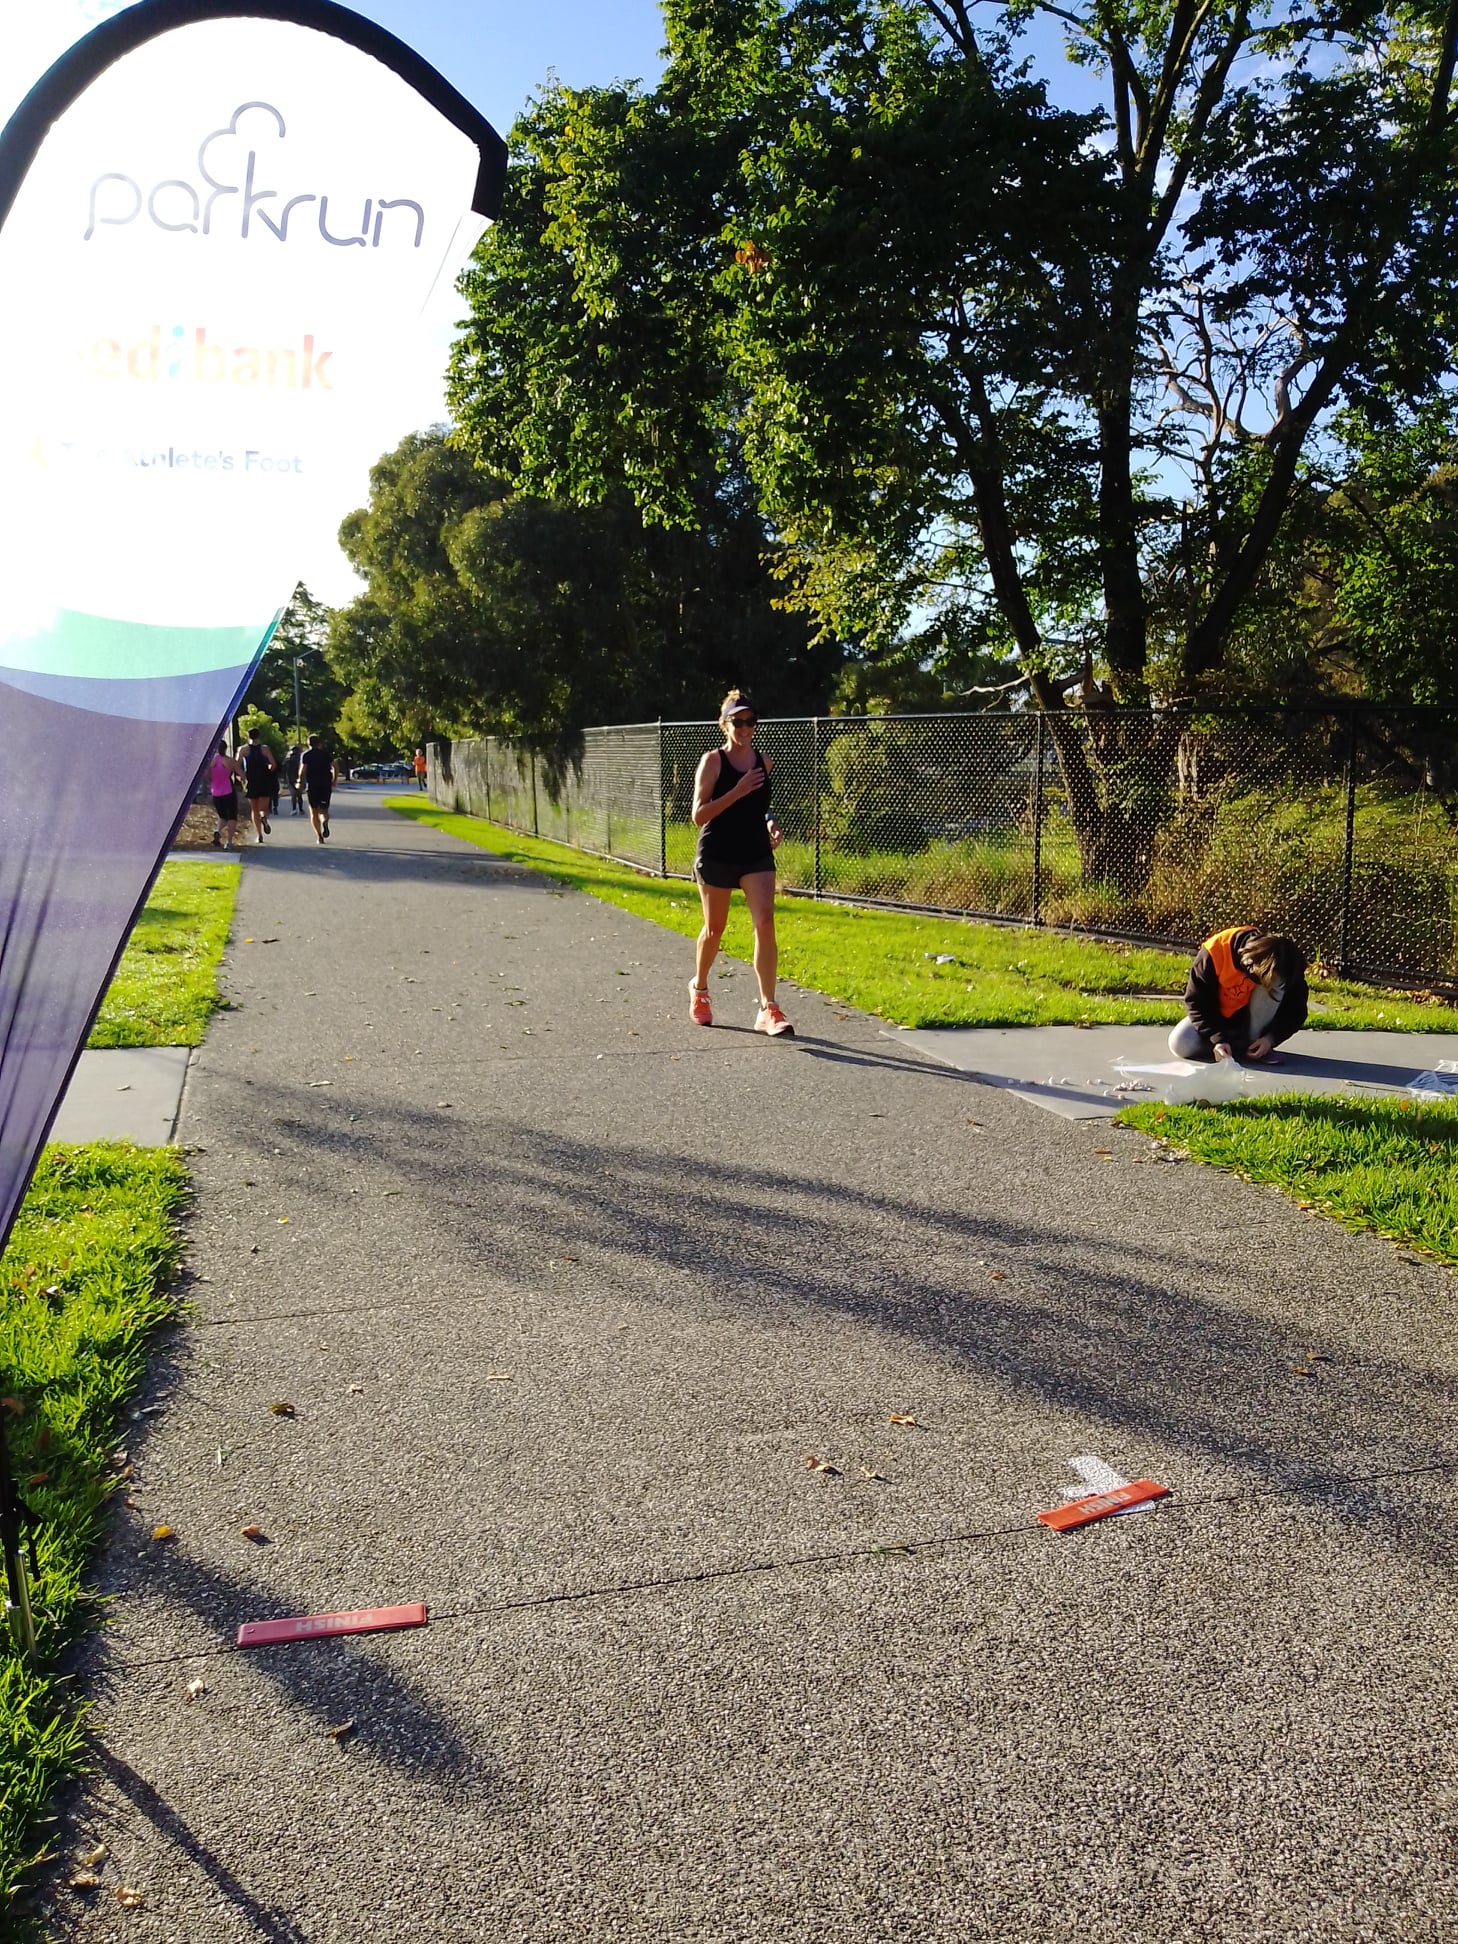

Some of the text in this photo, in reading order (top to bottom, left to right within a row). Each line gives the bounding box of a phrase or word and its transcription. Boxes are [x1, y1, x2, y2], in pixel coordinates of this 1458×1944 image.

[83, 101, 425, 248] parkrun
[77, 323, 335, 391] edibank
[244, 450, 303, 474] Foot
[1078, 1492, 1131, 1514] FINISH
[295, 1614, 372, 1632] FINISH
